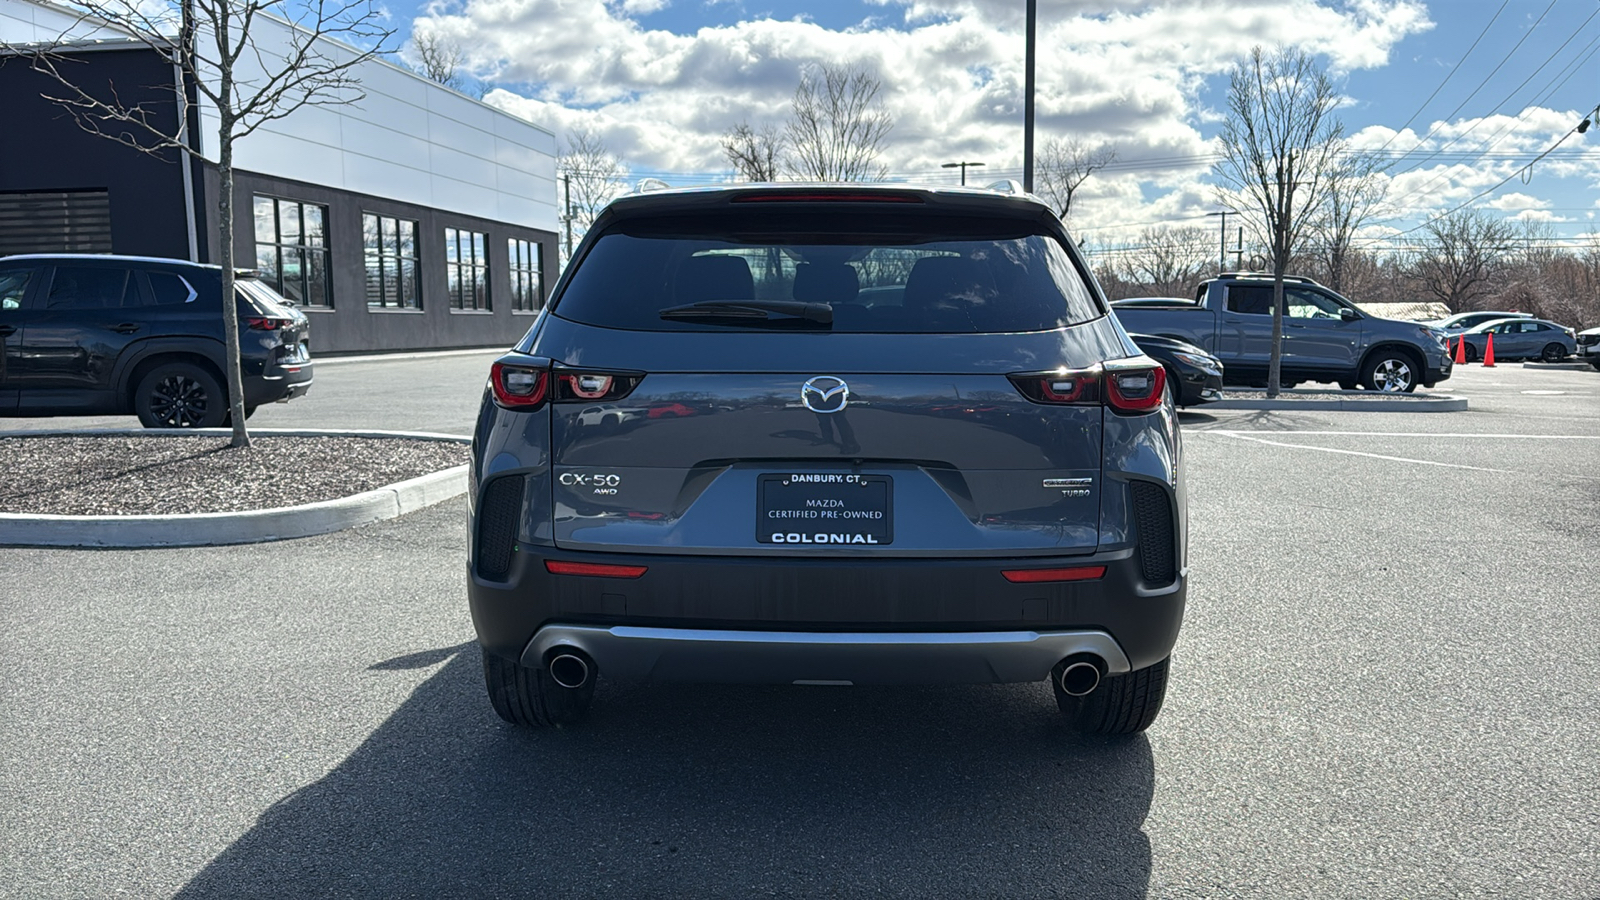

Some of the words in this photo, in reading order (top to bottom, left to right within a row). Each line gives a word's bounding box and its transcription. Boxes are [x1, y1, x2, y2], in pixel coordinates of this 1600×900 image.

[559, 473, 620, 487] CX-50
[791, 474, 843, 483] DANBURY,
[846, 475, 860, 483] CT
[1061, 489, 1090, 497] TURBO
[806, 499, 845, 508] MAZDA
[768, 510, 818, 519] CERTIFIED
[820, 510, 883, 519] PRE-OWNED
[771, 533, 878, 544] COLONIAL
